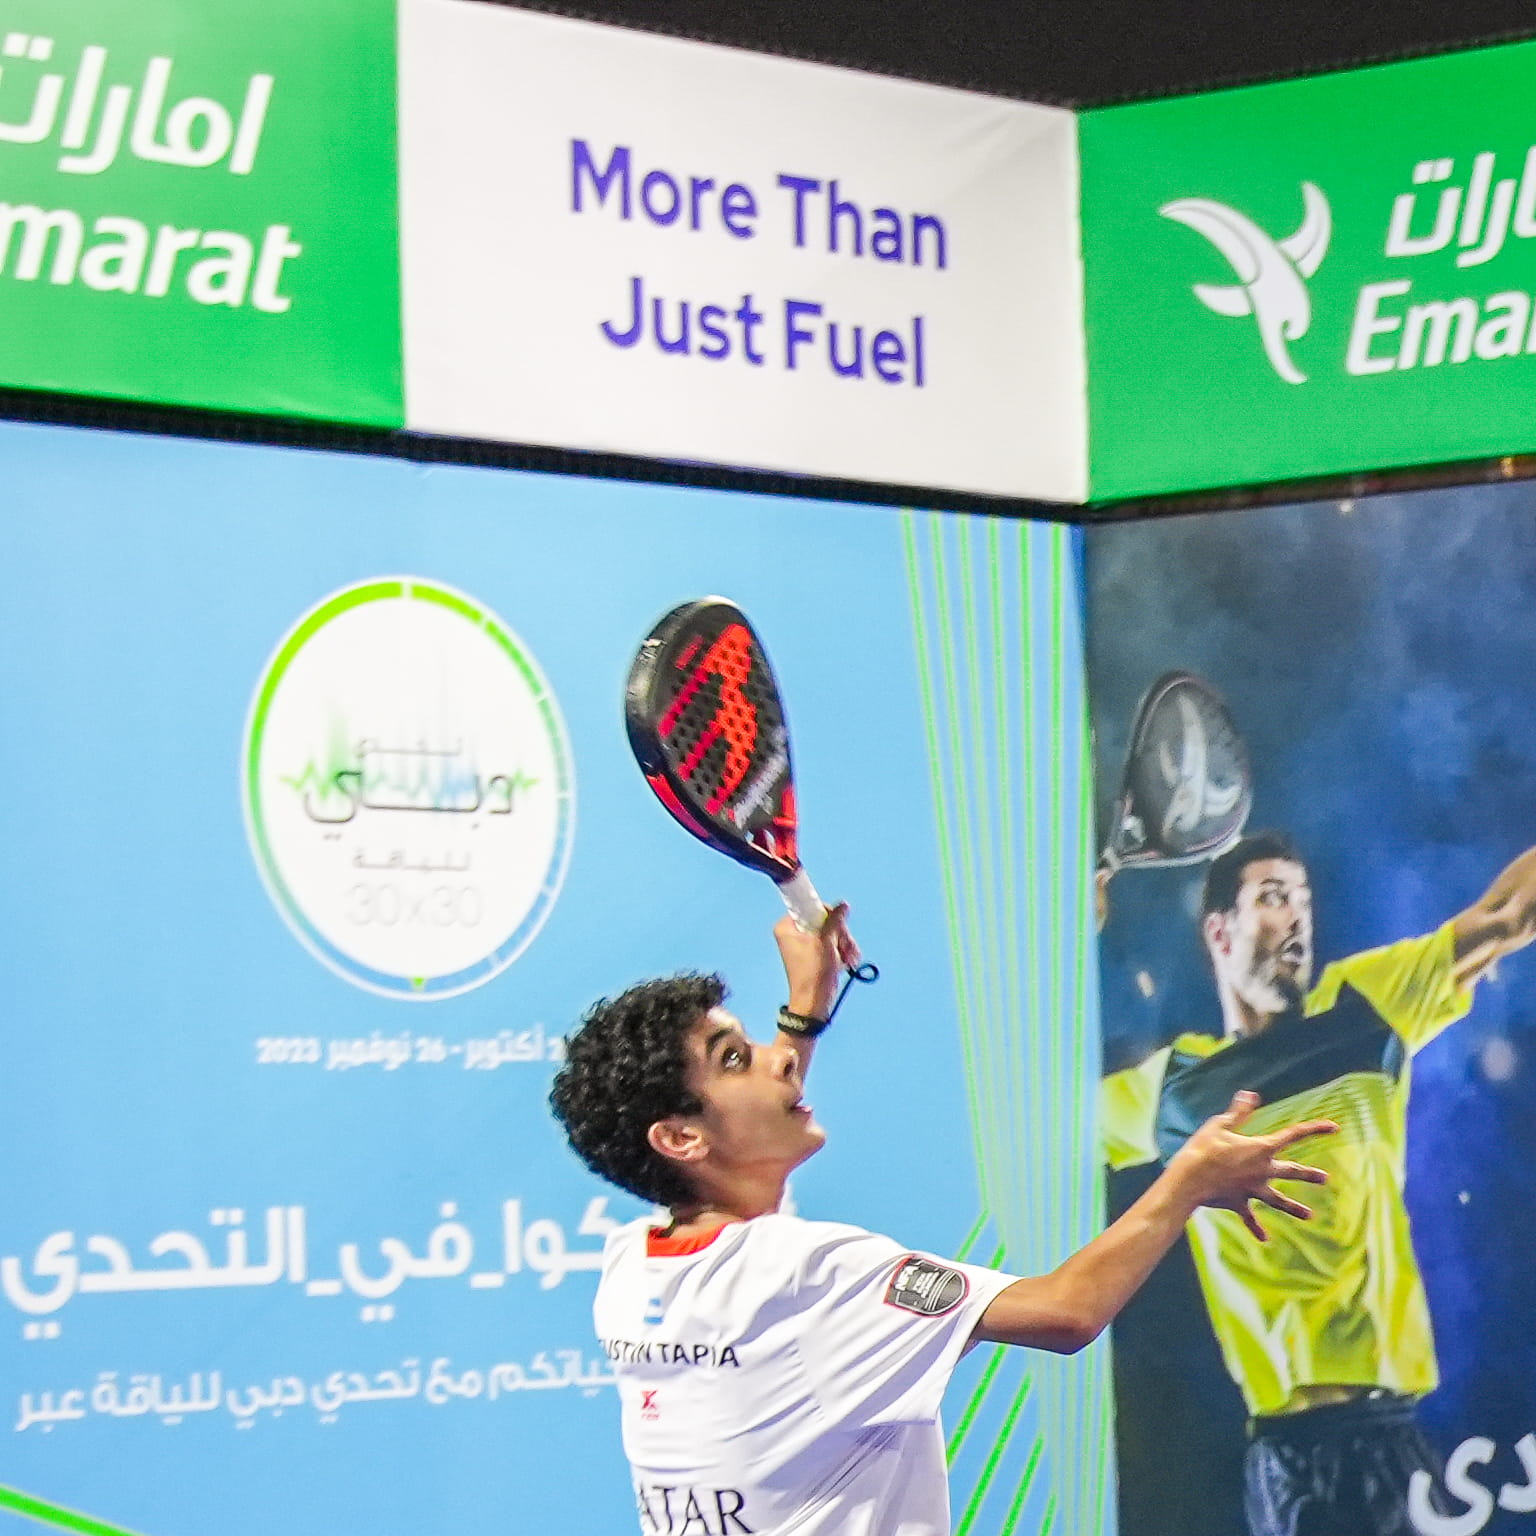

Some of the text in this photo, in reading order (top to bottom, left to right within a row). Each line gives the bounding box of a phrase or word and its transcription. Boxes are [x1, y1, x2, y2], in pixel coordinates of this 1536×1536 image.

[569, 138, 949, 272] More Than
[599, 276, 927, 389] Just Fuel
[425, 1356, 483, 1406] مع
[656, 1342, 741, 1368] TAPIA
[13, 1387, 86, 1433] عبر
[90, 1369, 222, 1427] للياقة
[226, 1375, 307, 1431] دبي
[310, 1356, 421, 1424] تحدي
